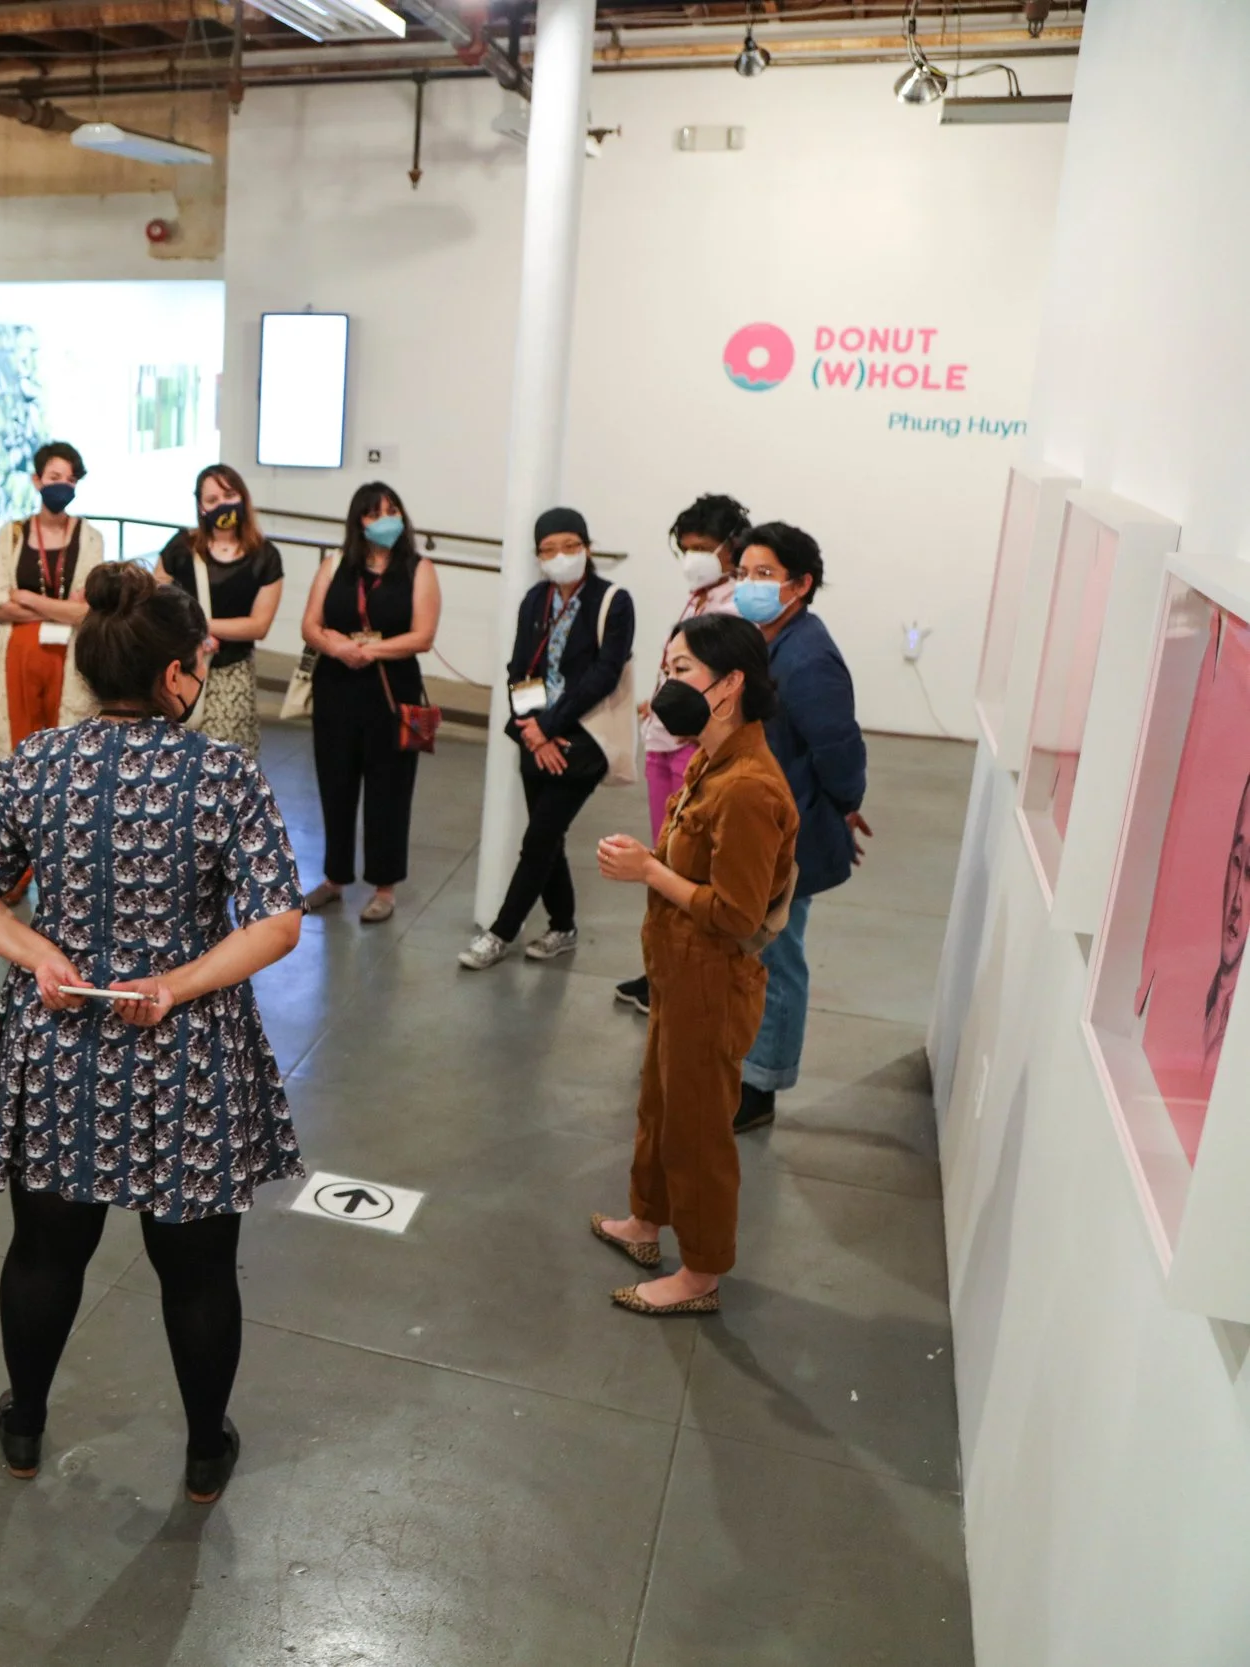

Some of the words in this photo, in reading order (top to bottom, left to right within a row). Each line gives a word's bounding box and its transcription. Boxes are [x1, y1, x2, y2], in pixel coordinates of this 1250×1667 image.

[814, 326, 938, 353] DONUT
[811, 356, 969, 391] (W)HOLE
[887, 411, 961, 438] Phung
